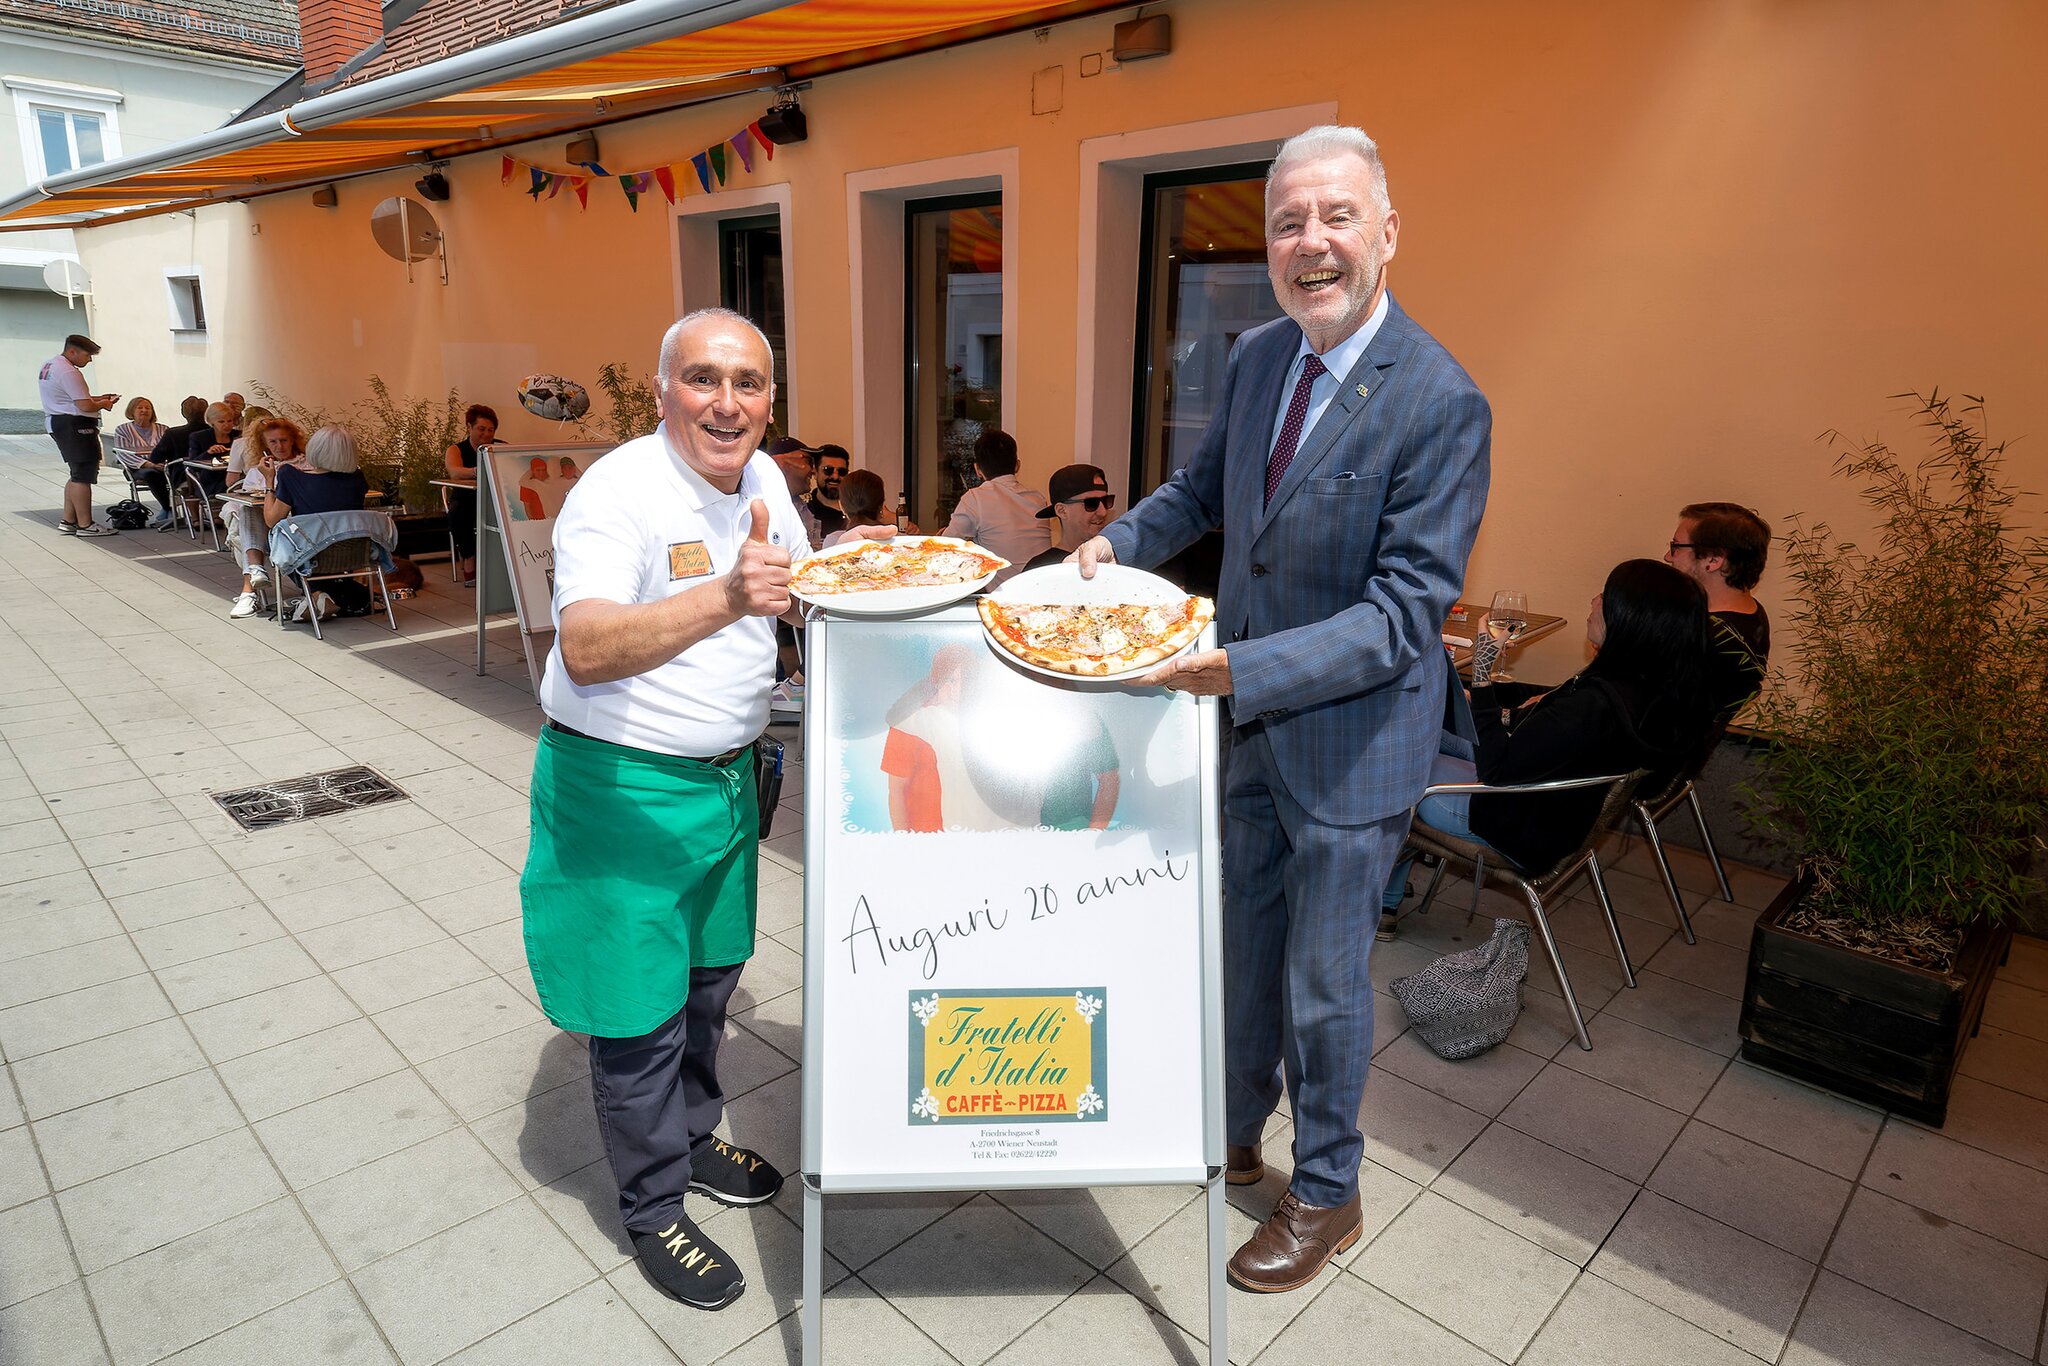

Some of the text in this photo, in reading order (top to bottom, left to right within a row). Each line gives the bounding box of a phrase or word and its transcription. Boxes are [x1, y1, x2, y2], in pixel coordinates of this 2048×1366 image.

[519, 540, 554, 567] Aug
[841, 850, 1189, 980] Auguri 20 anni
[938, 1006, 1067, 1046] Fratelli
[935, 1046, 1071, 1087] d'Italia
[946, 1089, 1068, 1113] CAFFÈ PIZZA
[969, 1139, 1058, 1149] A-2700 Wiener Neustadt
[1035, 1128, 1041, 1136] 8
[971, 1151, 985, 1159] Tel
[985, 1151, 992, 1159] &
